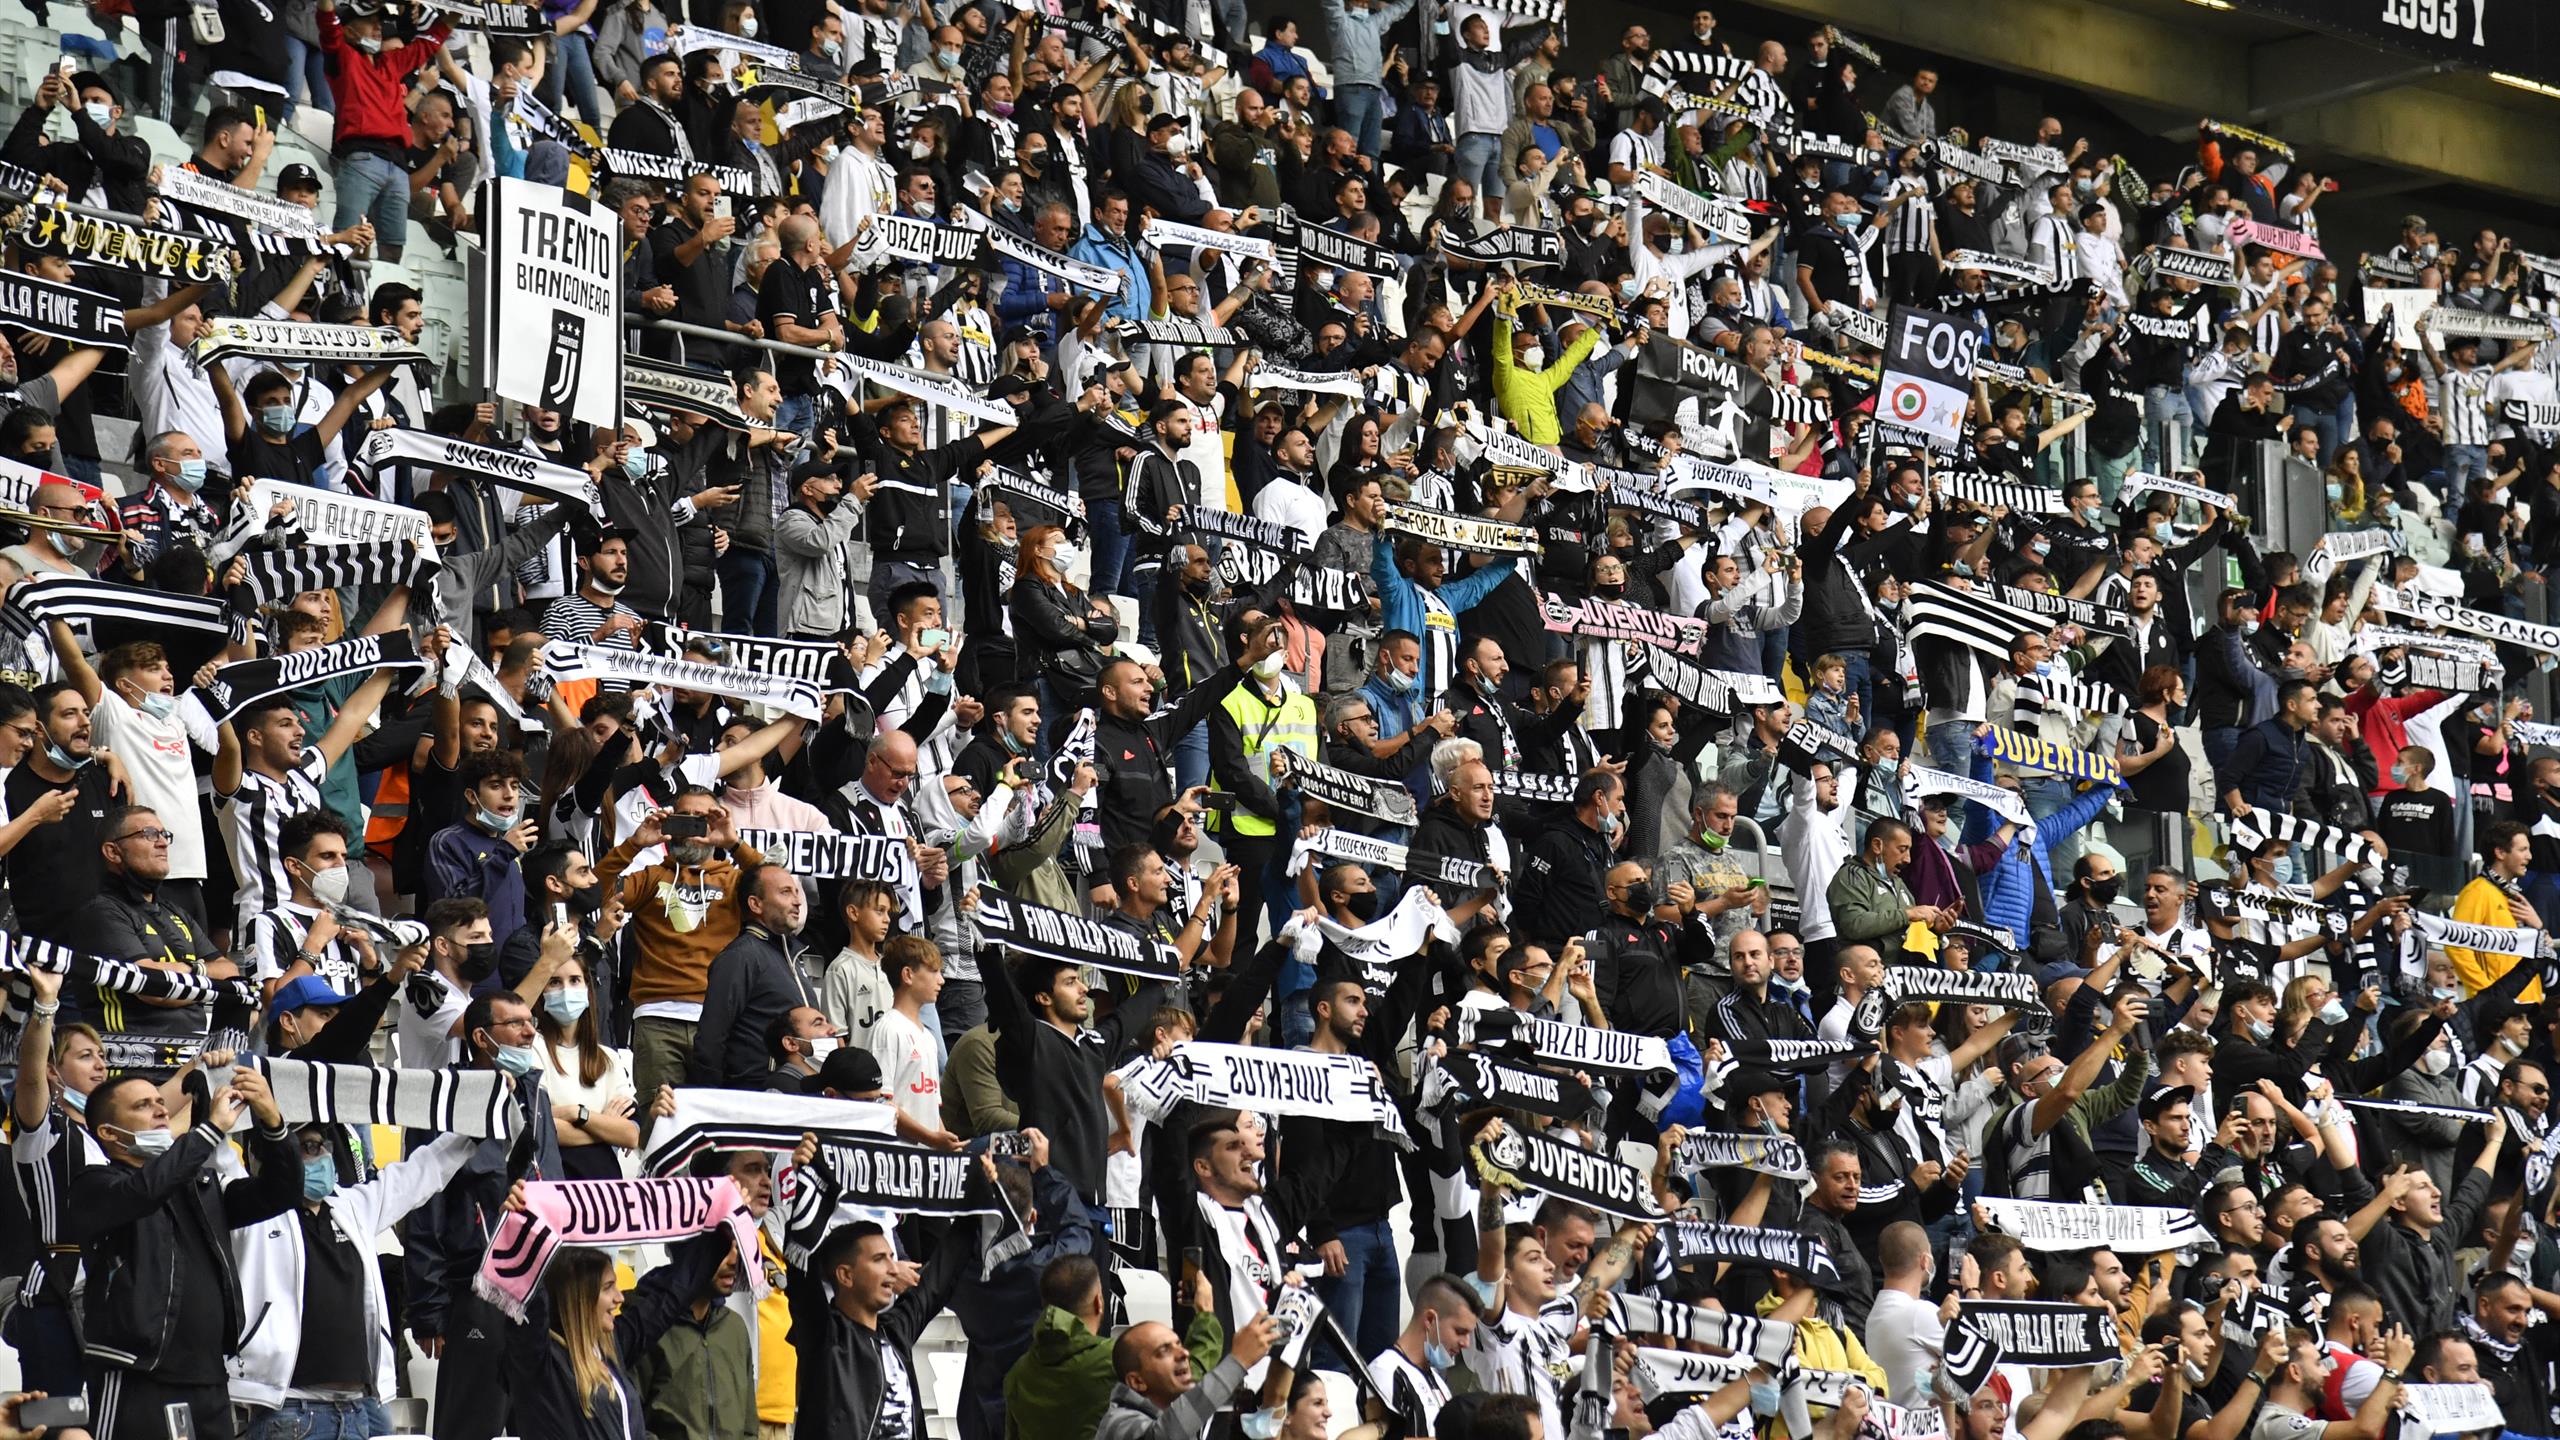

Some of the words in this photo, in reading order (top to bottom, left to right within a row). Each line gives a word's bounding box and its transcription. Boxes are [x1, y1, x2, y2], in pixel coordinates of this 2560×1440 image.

[502, 4, 529, 28] FINE
[60, 222, 183, 268] JUVENTUS
[518, 207, 609, 280] TRENTO
[877, 217, 932, 257] FORZA
[934, 230, 982, 260] JUVE
[980, 223, 1057, 271] UVENTUS
[1301, 227, 1316, 251] NO
[1317, 233, 1343, 256] ALLA
[1344, 239, 1367, 267] FINE
[1514, 232, 1535, 255] FINE
[2255, 225, 2301, 251] JUVENTUS
[37, 290, 80, 329] FINE
[517, 262, 610, 318] BIANCONERA
[249, 322, 371, 348] JUVENTUS
[1682, 347, 1740, 392] ROMA
[949, 410, 970, 425] eep
[445, 443, 538, 481] JUVENTUS
[1690, 462, 1752, 491] JUVENTUS
[270, 490, 317, 533] FNO
[326, 503, 377, 544] ALLA
[377, 513, 431, 550] FINE
[1612, 482, 1641, 506] FINO
[1672, 500, 1700, 528] FINE
[1194, 504, 1226, 531] FINO
[1256, 521, 1285, 550] FINE
[1408, 511, 1449, 539] FORZA
[1473, 524, 1504, 546] JUVE
[1579, 598, 1676, 638] JUVENTUS
[2002, 584, 2034, 611] FINO
[2036, 590, 2066, 614] ALLA
[2067, 600, 2096, 625] FINE
[2418, 599, 2560, 649] FOSSANO
[278, 636, 382, 685] JUVENTUS
[664, 631, 839, 686] JUVENS
[1993, 724, 2120, 785] JUVENTUS
[1292, 756, 1372, 794] JUVENTUS
[1300, 775, 1328, 796] 080911
[1331, 786, 1340, 799] IO
[1334, 834, 1388, 862] JUVENTUS
[1438, 856, 1484, 888] 1897
[1019, 904, 1065, 946] FINO
[1060, 913, 1107, 955] ALLA
[1100, 924, 1144, 962] FINE
[2438, 923, 2519, 953] JUVENTUS
[310, 951, 354, 982] Jeep
[1361, 962, 1397, 988] Jeep
[2234, 960, 2259, 980] Jeep
[858, 1006, 885, 1029] Je
[1535, 1019, 1586, 1059] ORZA
[1592, 1030, 1644, 1066] JUVE
[1767, 1039, 1854, 1062] JUVENTUS
[1494, 1066, 1560, 1103] JUVENTUS
[821, 1145, 871, 1193] FINO
[873, 1151, 923, 1199] ALLA
[927, 1156, 971, 1200] FINE
[1529, 1141, 1635, 1203] JUVENTUS
[555, 1179, 715, 1235] JUVENTUS
[1679, 1221, 1715, 1257] FINE
[1760, 1228, 1802, 1267] FINO
[1976, 1312, 2014, 1353] FINO
[2013, 1313, 2053, 1354] ALLA
[2053, 1313, 2091, 1353] FINE
